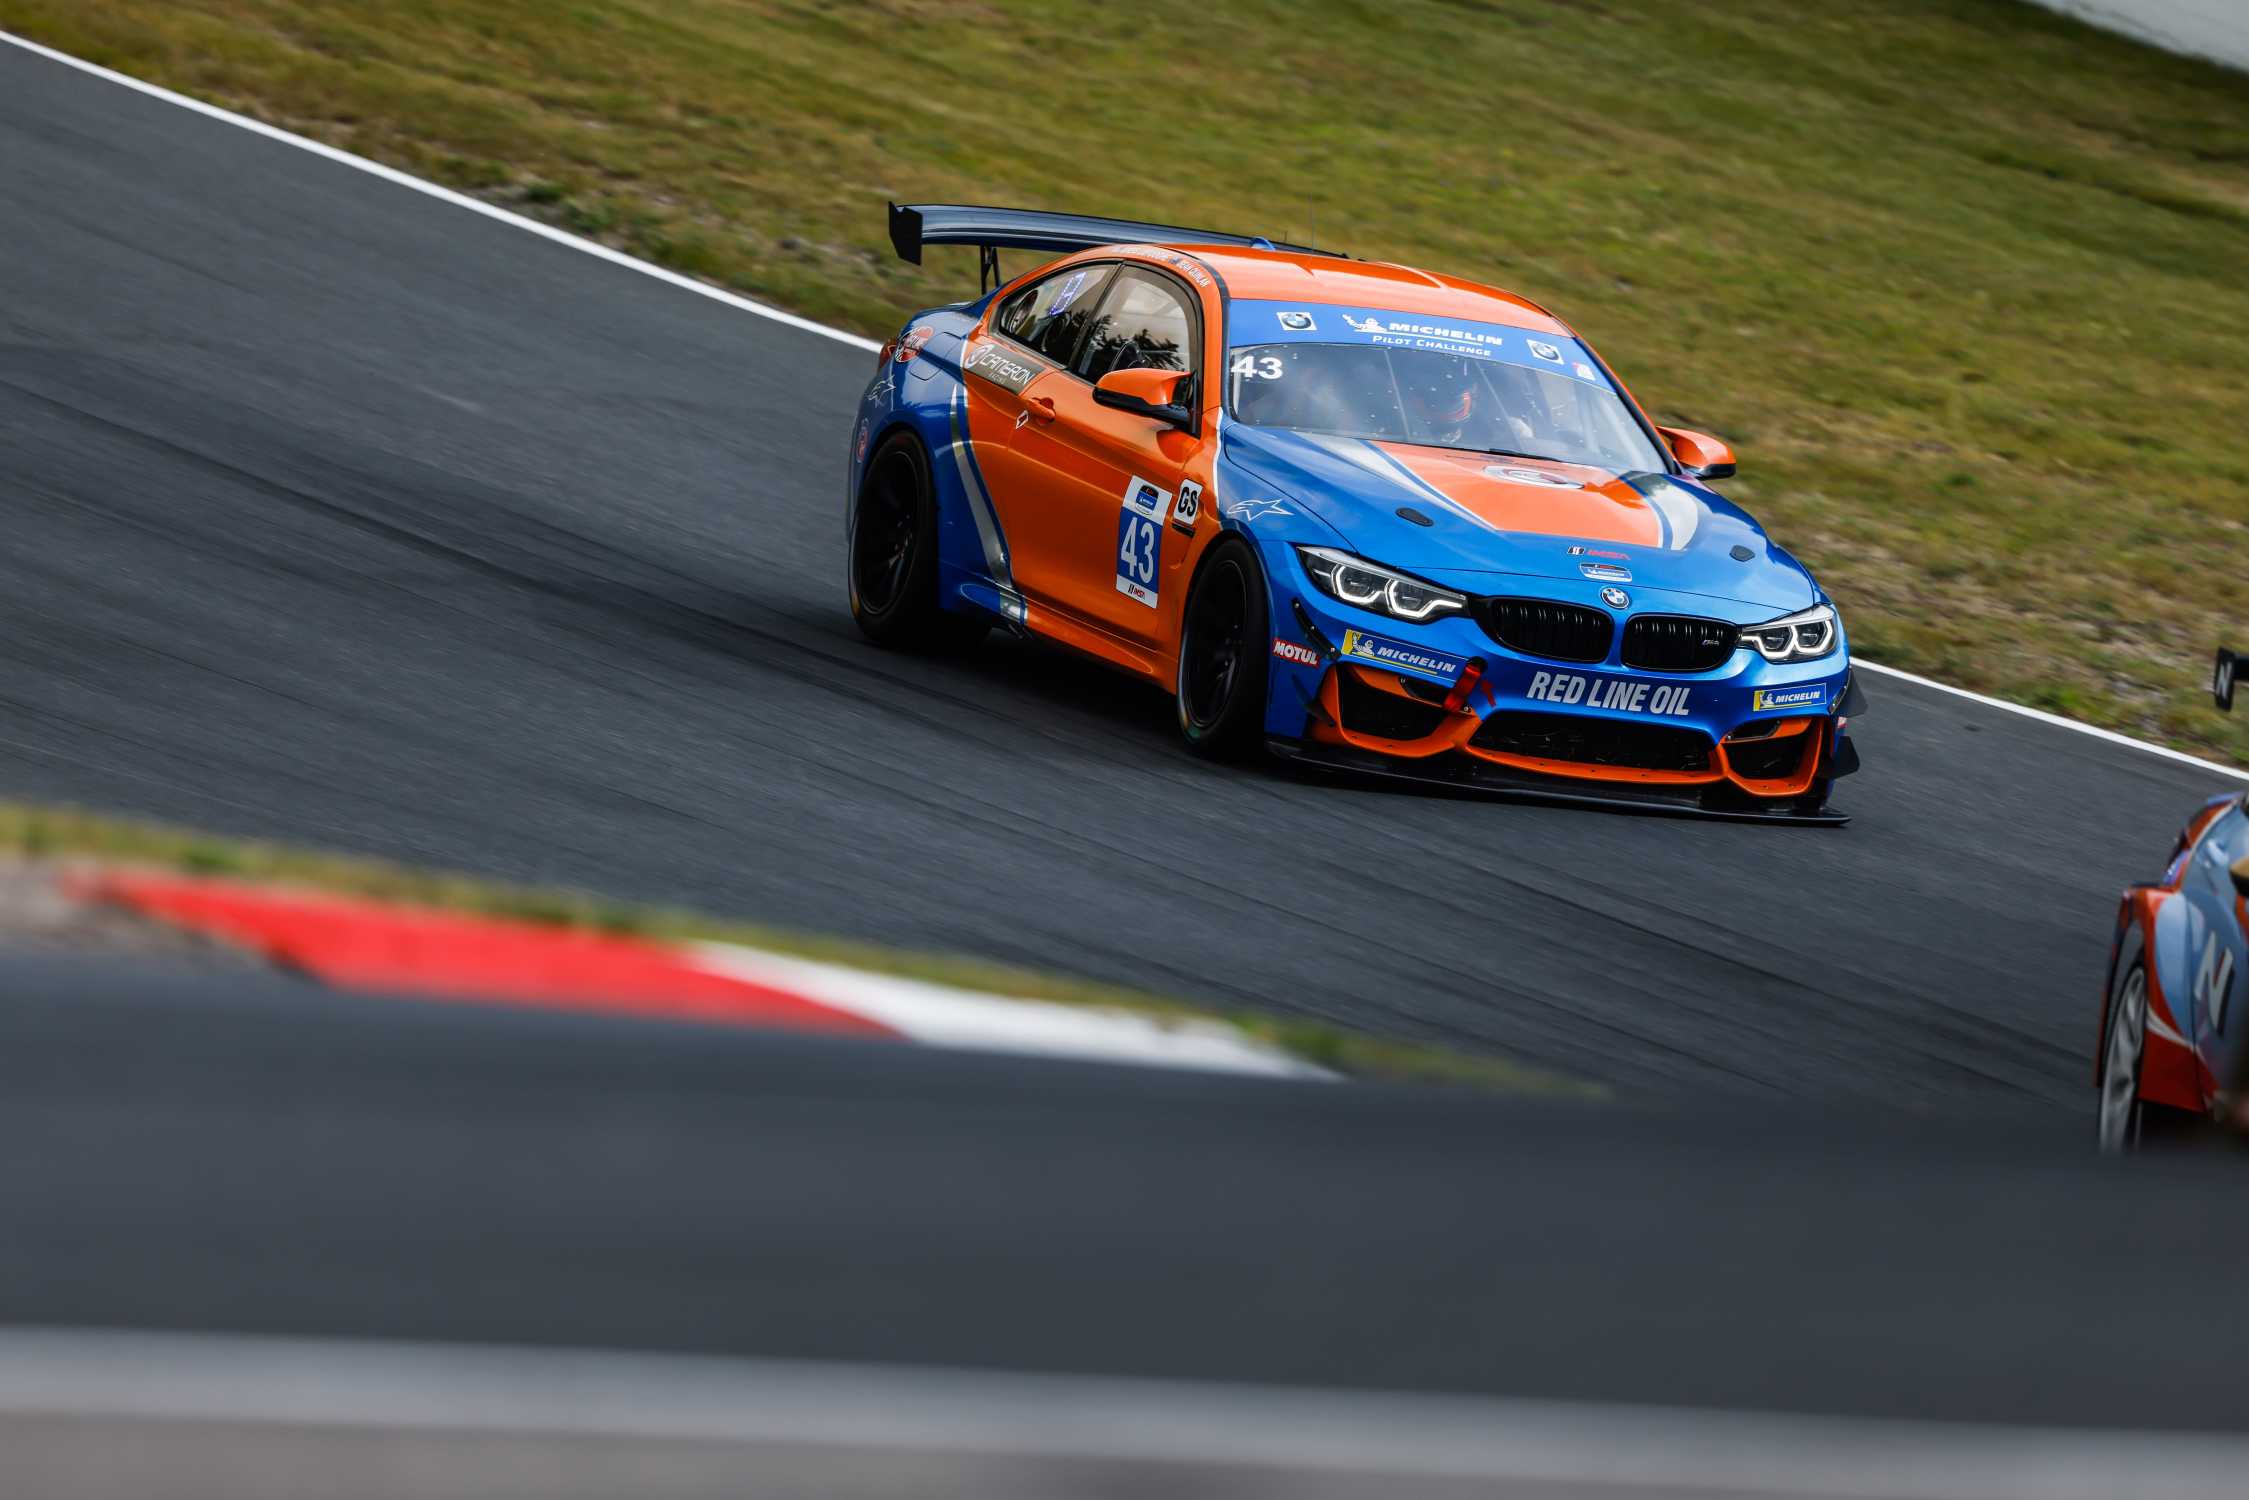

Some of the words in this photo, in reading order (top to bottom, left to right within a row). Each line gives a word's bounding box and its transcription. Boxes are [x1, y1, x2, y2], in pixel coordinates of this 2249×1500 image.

[1388, 322, 1503, 346] MICHELIN
[979, 353, 1035, 385] CAMERON
[1231, 356, 1284, 380] 43
[1178, 486, 1198, 518] GS
[1120, 516, 1155, 584] 43
[1273, 641, 1318, 665] MOTUL
[1377, 645, 1457, 673] MICHELIN
[1526, 671, 1586, 705] RED
[1586, 679, 1650, 712] LINE
[1649, 685, 1691, 716] OIL
[1775, 691, 1821, 703] MICHELIN
